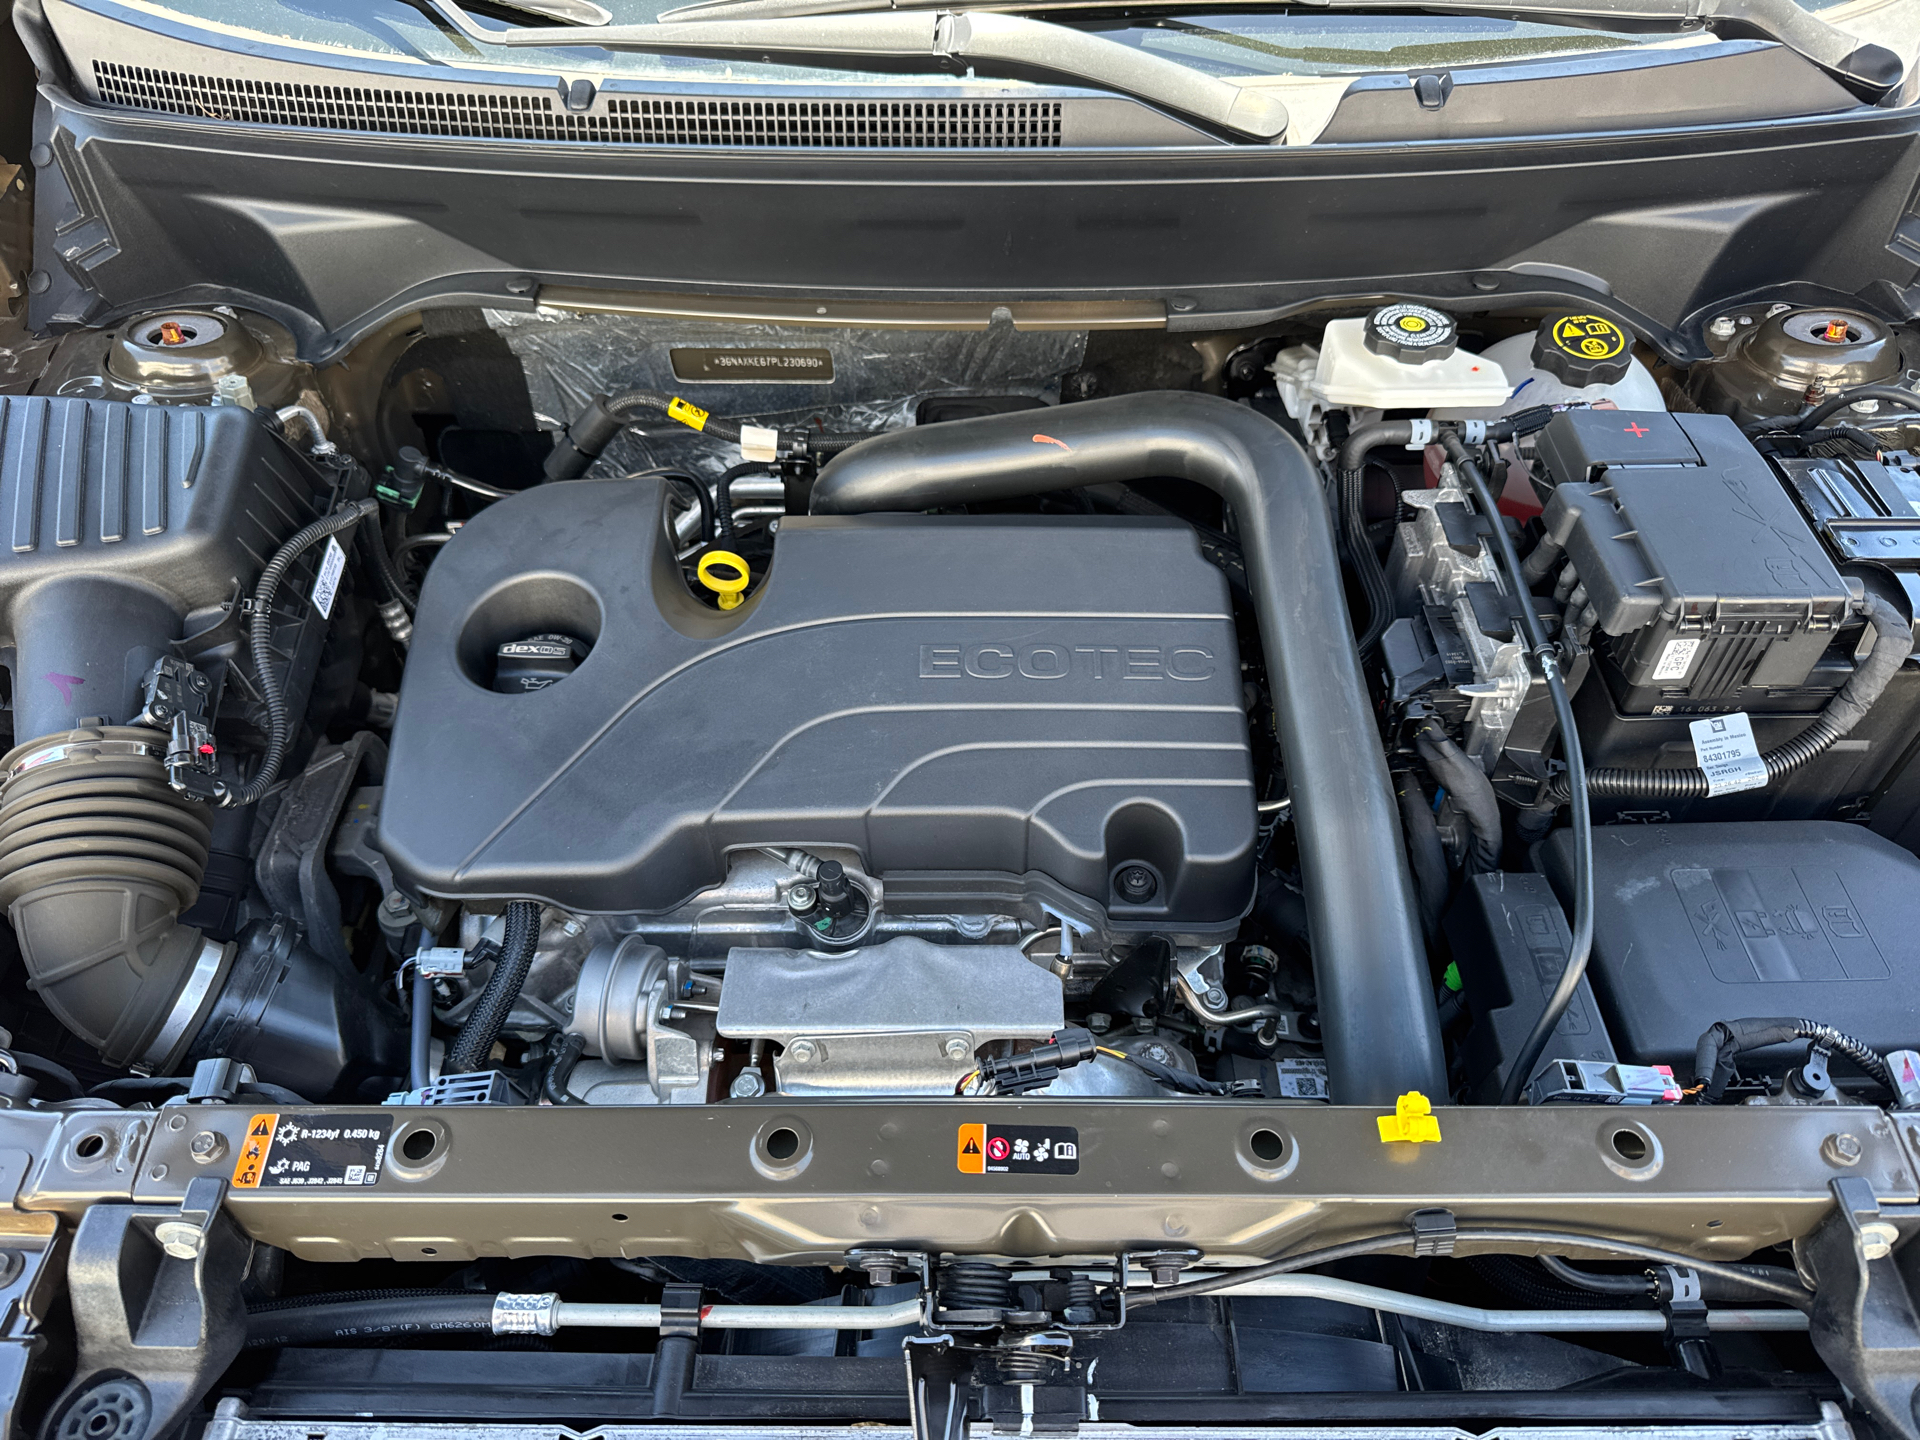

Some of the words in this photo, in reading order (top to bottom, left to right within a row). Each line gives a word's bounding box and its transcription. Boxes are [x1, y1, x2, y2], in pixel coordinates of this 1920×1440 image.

[548, 634, 573, 644] 0W-20
[502, 643, 567, 656] dexos
[919, 644, 1215, 682] ECOTEC
[1670, 656, 1684, 671] GPC
[1702, 736, 1723, 745] Assembly
[1702, 749, 1741, 763] 84301795
[1710, 766, 1742, 777] JSRGH
[301, 1129, 340, 1140] R-1234yf
[343, 1129, 368, 1139] 0.450
[369, 1129, 380, 1140] kg
[1012, 1152, 1030, 1160] AUTO
[292, 1161, 310, 1172] PAG
